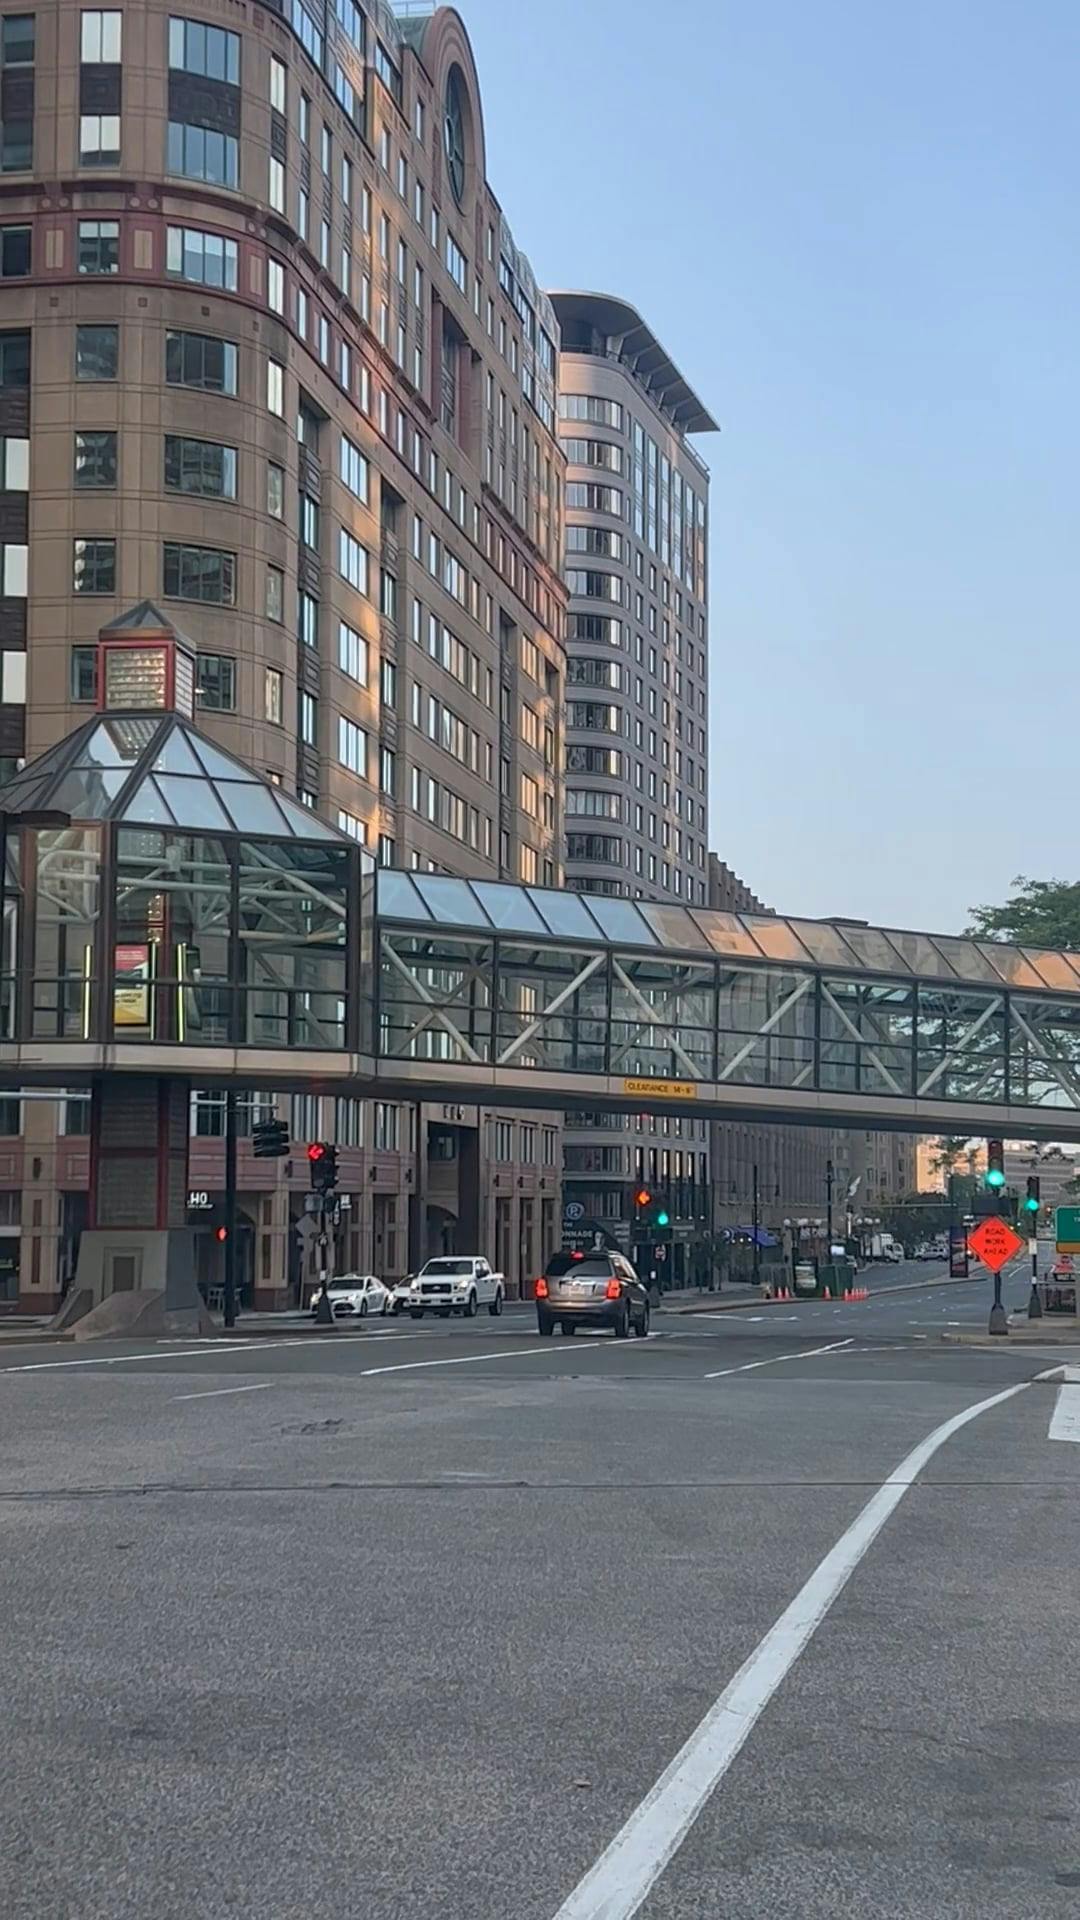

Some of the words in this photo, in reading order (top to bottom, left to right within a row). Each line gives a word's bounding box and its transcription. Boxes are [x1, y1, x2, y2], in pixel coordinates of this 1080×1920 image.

[627, 1082, 668, 1093] CLEARANCE
[984, 1227, 1006, 1235] ROAD
[985, 1238, 1006, 1246] WORK
[983, 1247, 1008, 1256] AHEAD
